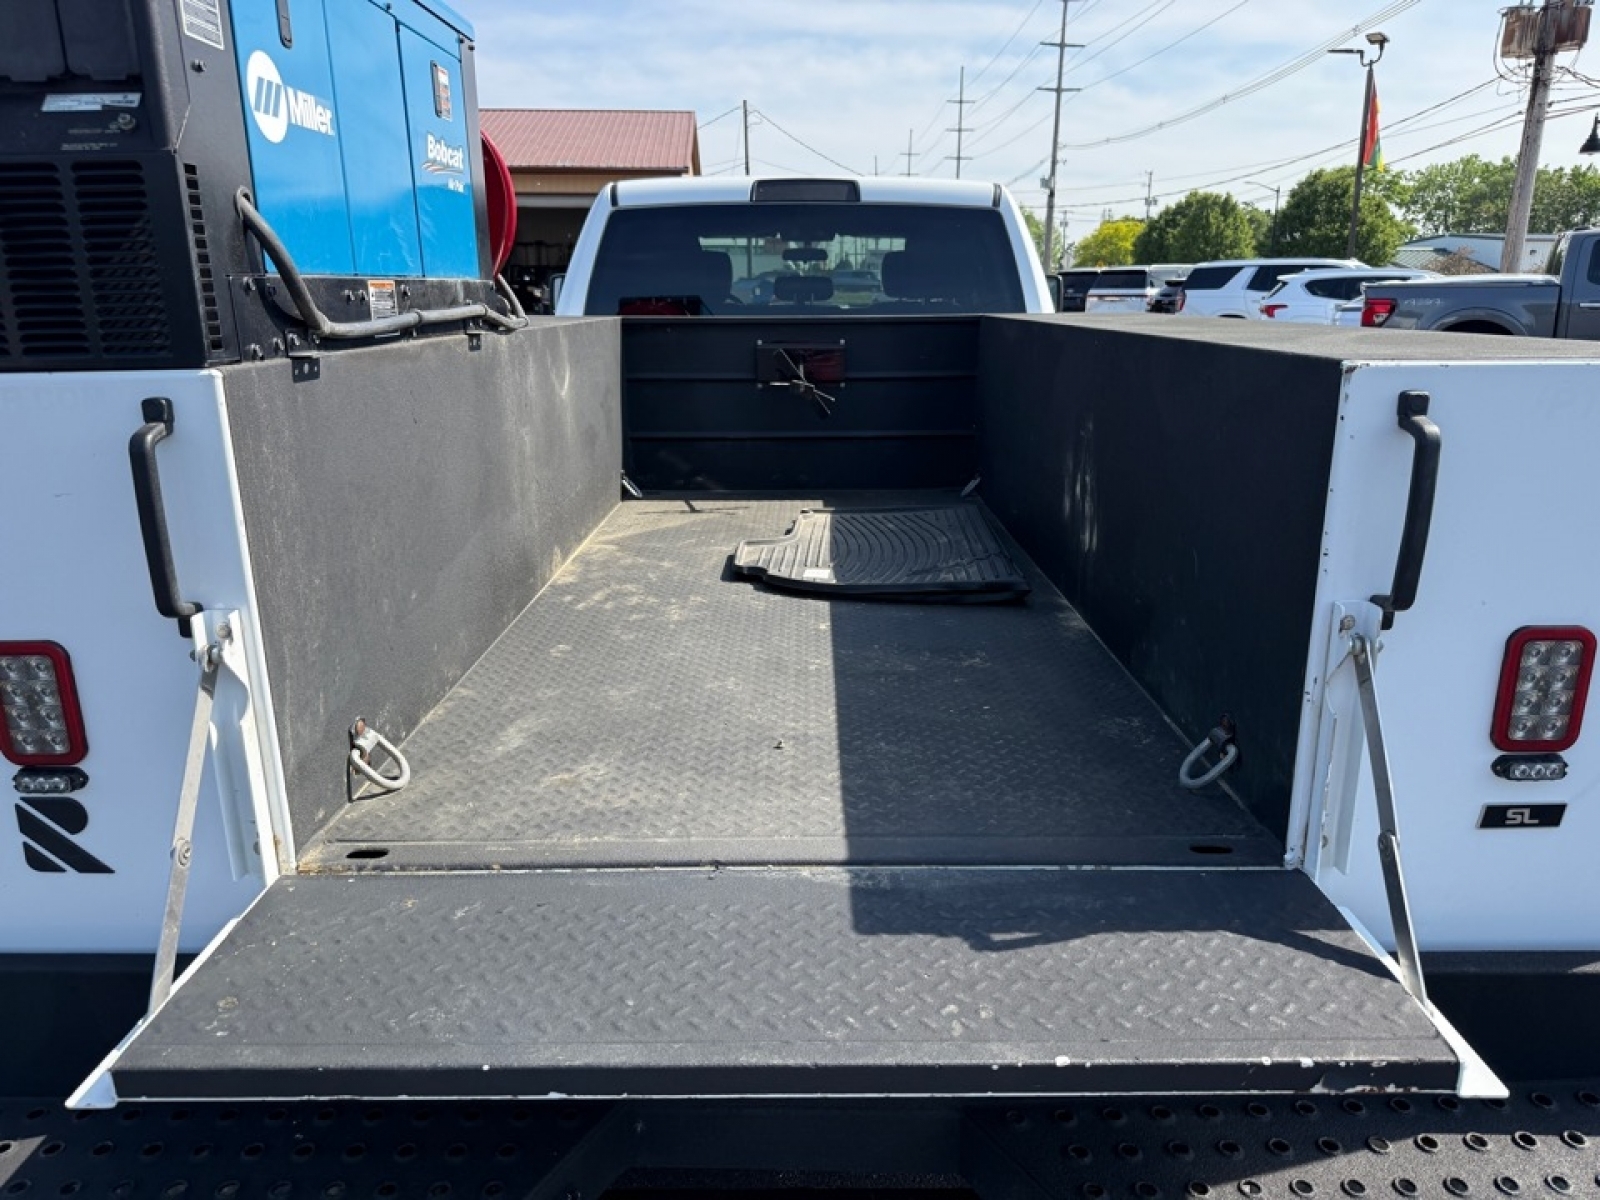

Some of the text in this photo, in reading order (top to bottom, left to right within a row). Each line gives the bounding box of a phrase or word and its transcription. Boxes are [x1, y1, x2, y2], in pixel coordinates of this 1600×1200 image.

[286, 86, 333, 136] Miller
[427, 133, 464, 170] Bobcat
[1504, 807, 1540, 825] SL
